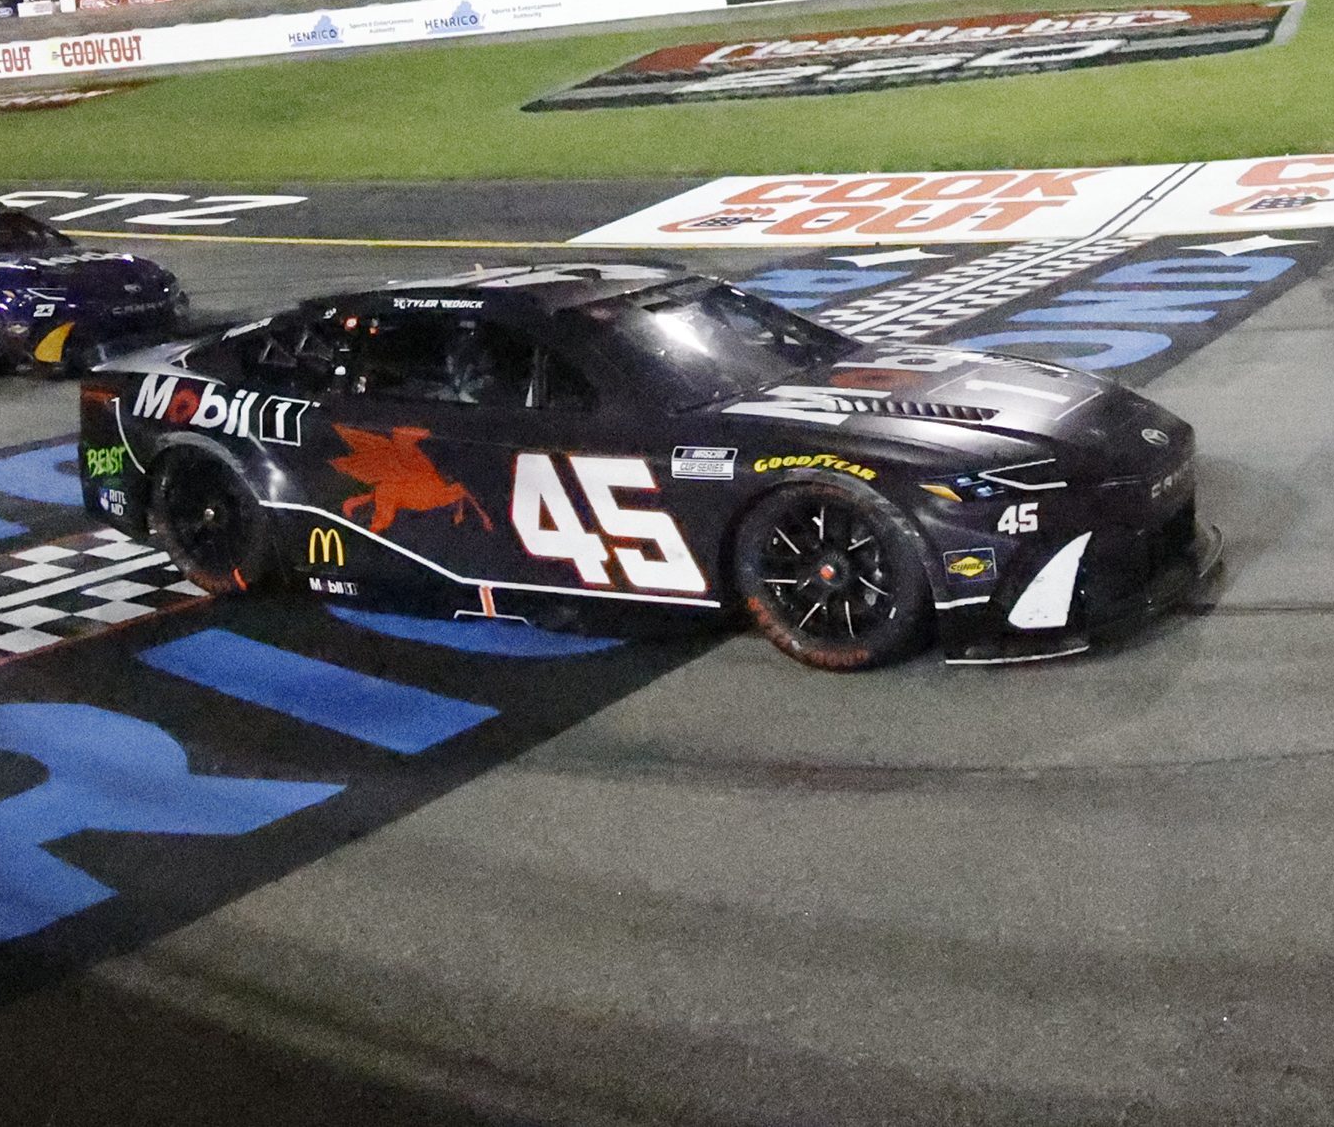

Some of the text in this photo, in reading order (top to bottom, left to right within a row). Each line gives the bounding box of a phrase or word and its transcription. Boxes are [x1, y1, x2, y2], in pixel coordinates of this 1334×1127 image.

[288, 29, 338, 42] HENRICO
[424, 14, 478, 30] HENRICO
[1, 46, 31, 72] OUT
[60, 35, 142, 67] COOK OUT
[721, 169, 1113, 205] COOK
[761, 200, 1066, 235] OUT
[407, 298, 484, 309] TYLER REDDICK
[132, 374, 259, 438] Mobil
[510, 452, 708, 594] 45
[997, 502, 1039, 535] 45
